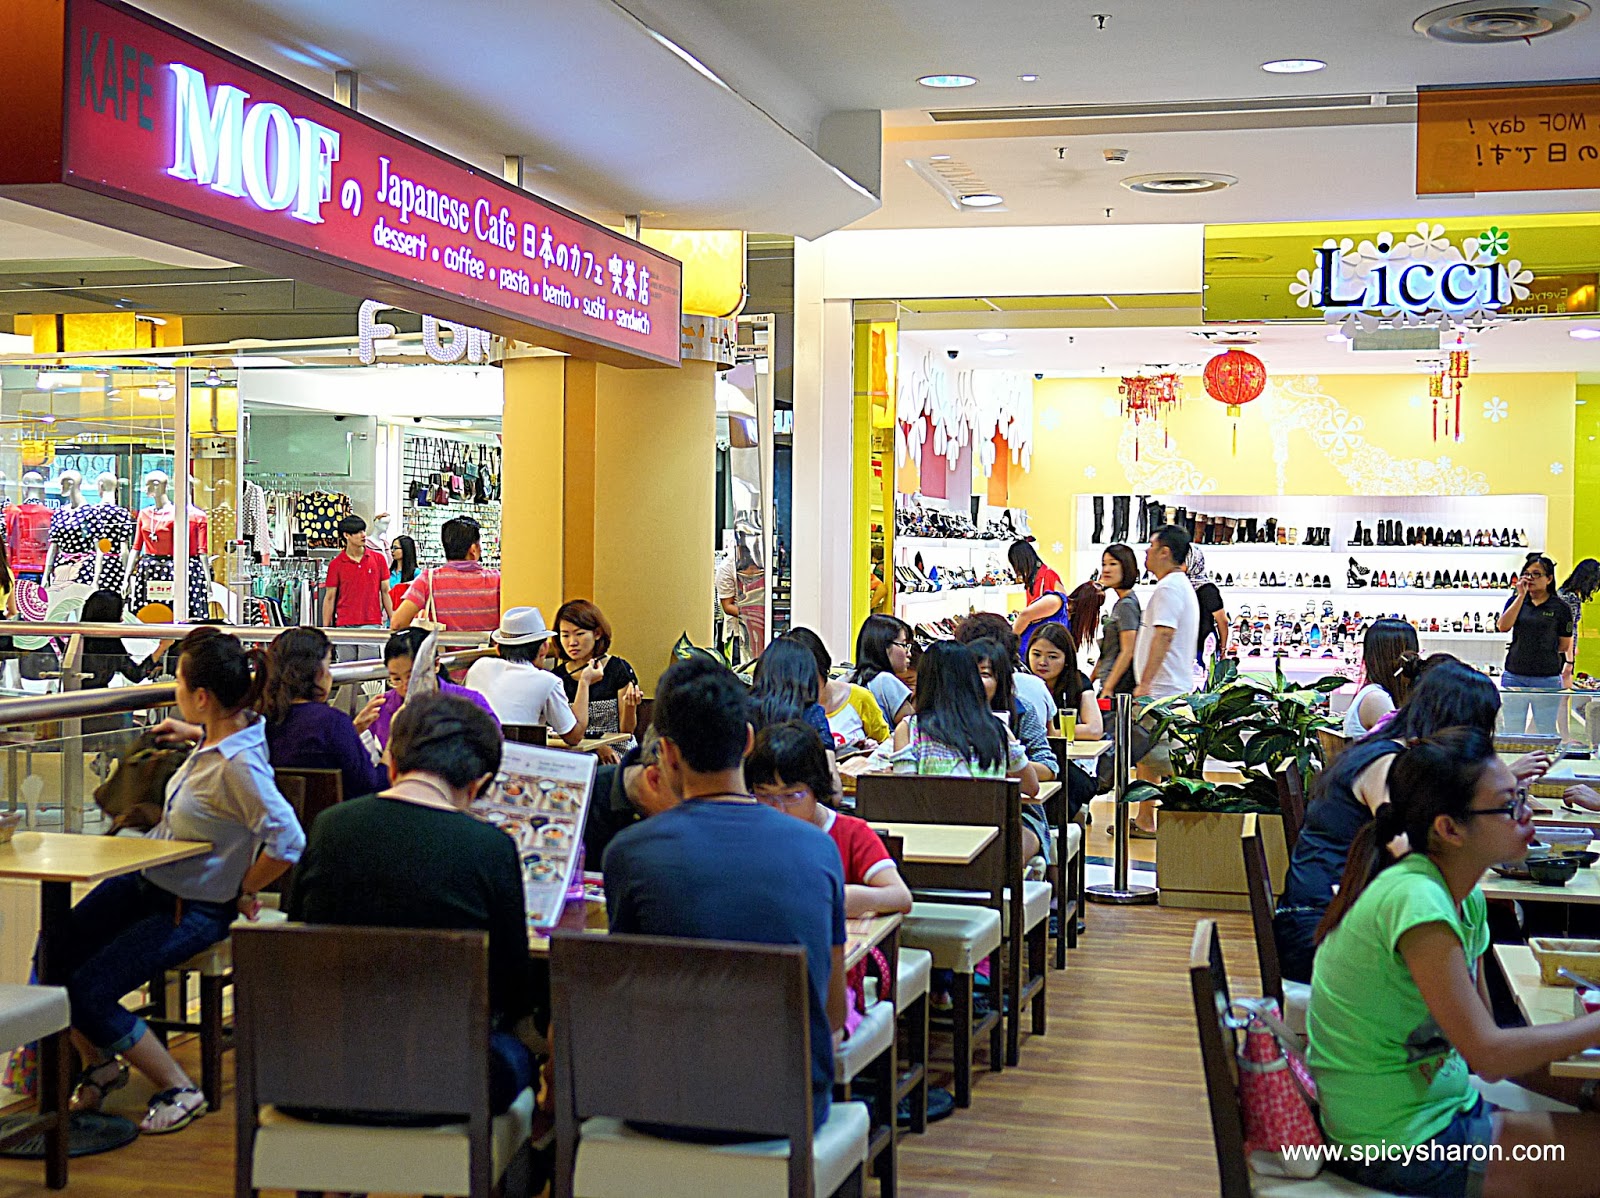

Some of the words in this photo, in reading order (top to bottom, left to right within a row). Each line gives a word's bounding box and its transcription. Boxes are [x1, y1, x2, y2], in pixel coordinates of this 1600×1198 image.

[78, 26, 155, 132] KAFE
[166, 62, 341, 224] MOF
[341, 180, 362, 217] の
[376, 156, 470, 234] Japanese
[474, 198, 516, 252] Cafe
[373, 216, 428, 261] dessert
[444, 246, 486, 280] coffee
[499, 267, 531, 296] pasta
[542, 276, 572, 309] bento
[582, 295, 606, 321] sushi
[616, 307, 650, 335] sandwich
[1312, 242, 1507, 308] Licci
